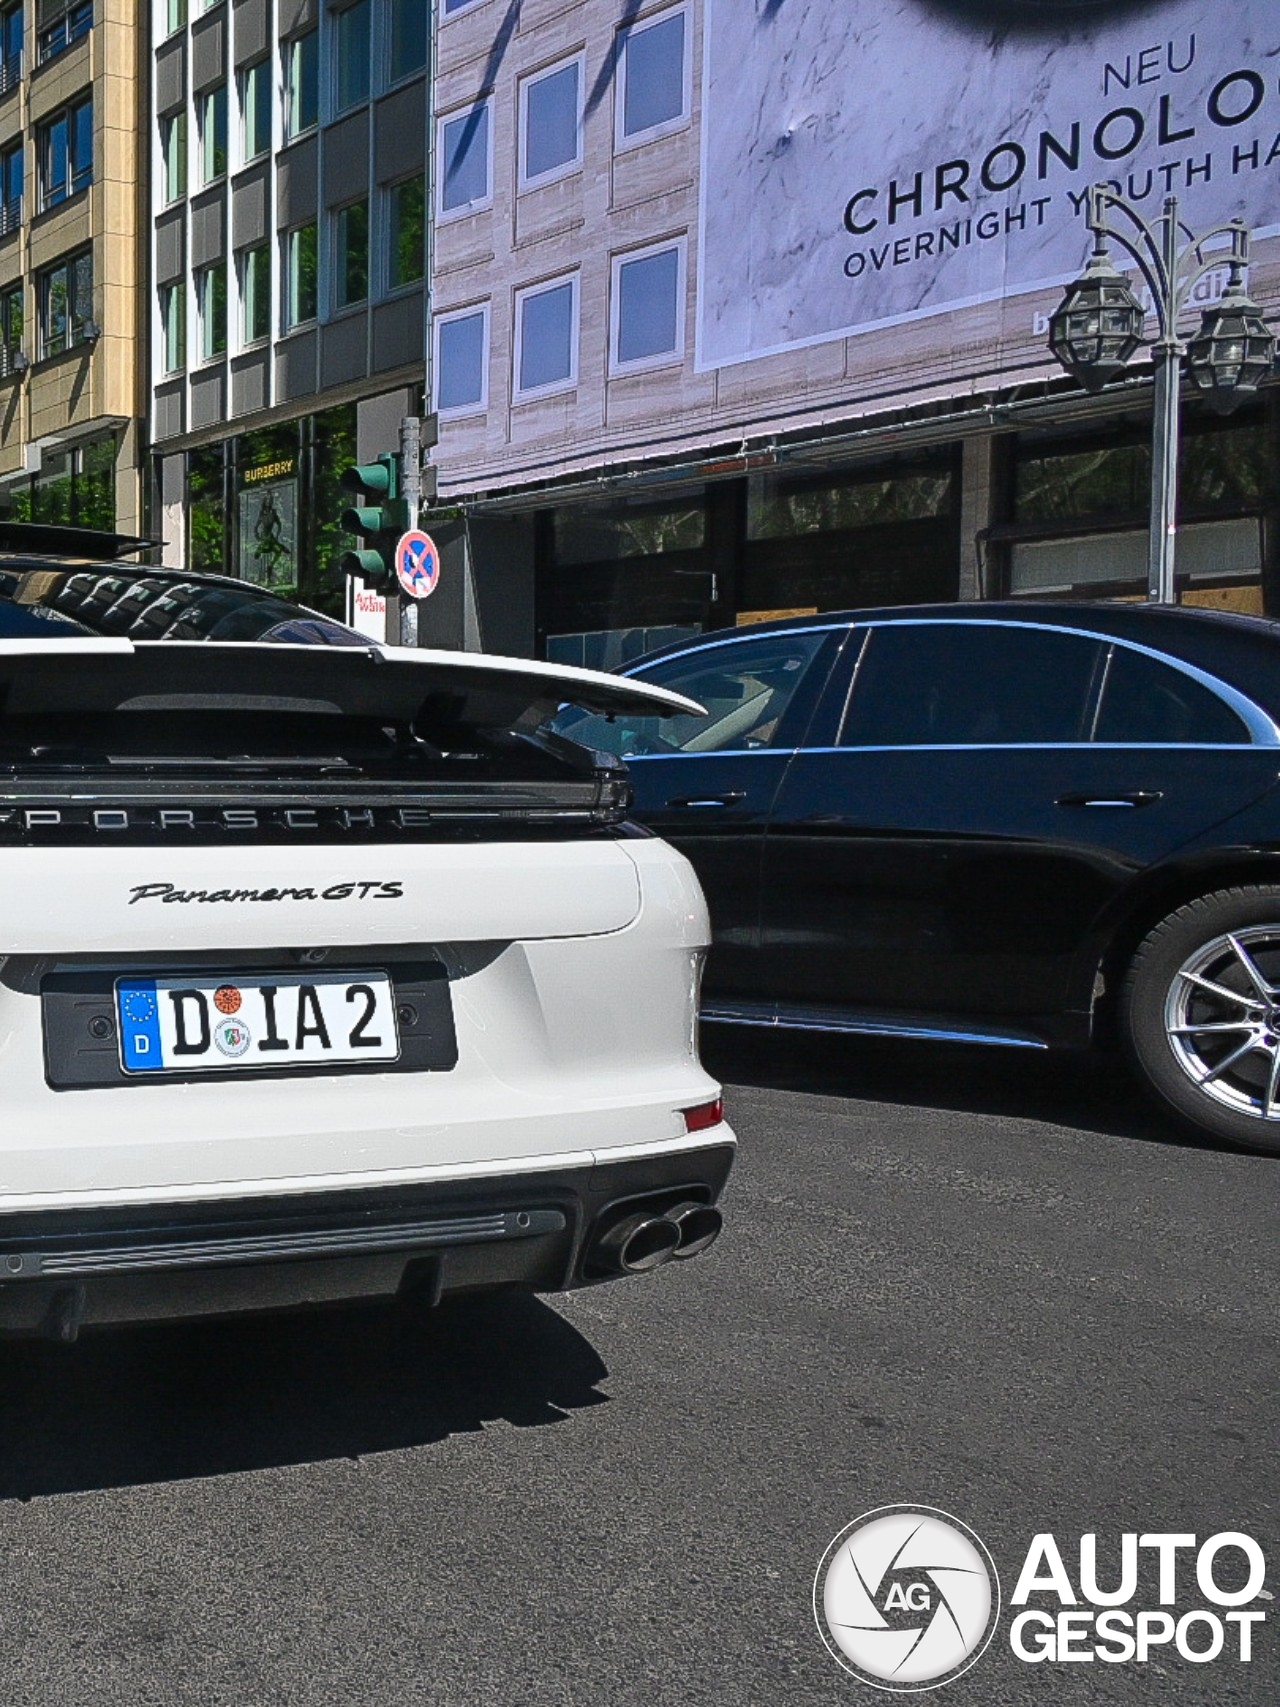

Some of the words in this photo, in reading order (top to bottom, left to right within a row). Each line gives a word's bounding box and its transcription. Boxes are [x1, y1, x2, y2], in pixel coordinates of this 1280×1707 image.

[1103, 33, 1196, 97] NEU
[843, 69, 1280, 235] CHRONOLO
[843, 196, 1051, 278] OVERNIGHT
[244, 459, 294, 483] BURBERRY
[25, 810, 430, 830] PORSCHE
[128, 882, 318, 905] Panamera
[321, 881, 404, 900] GTS
[169, 989, 211, 1055] D
[258, 985, 332, 1051] IA
[345, 984, 383, 1048] 2
[135, 1035, 150, 1054] D
